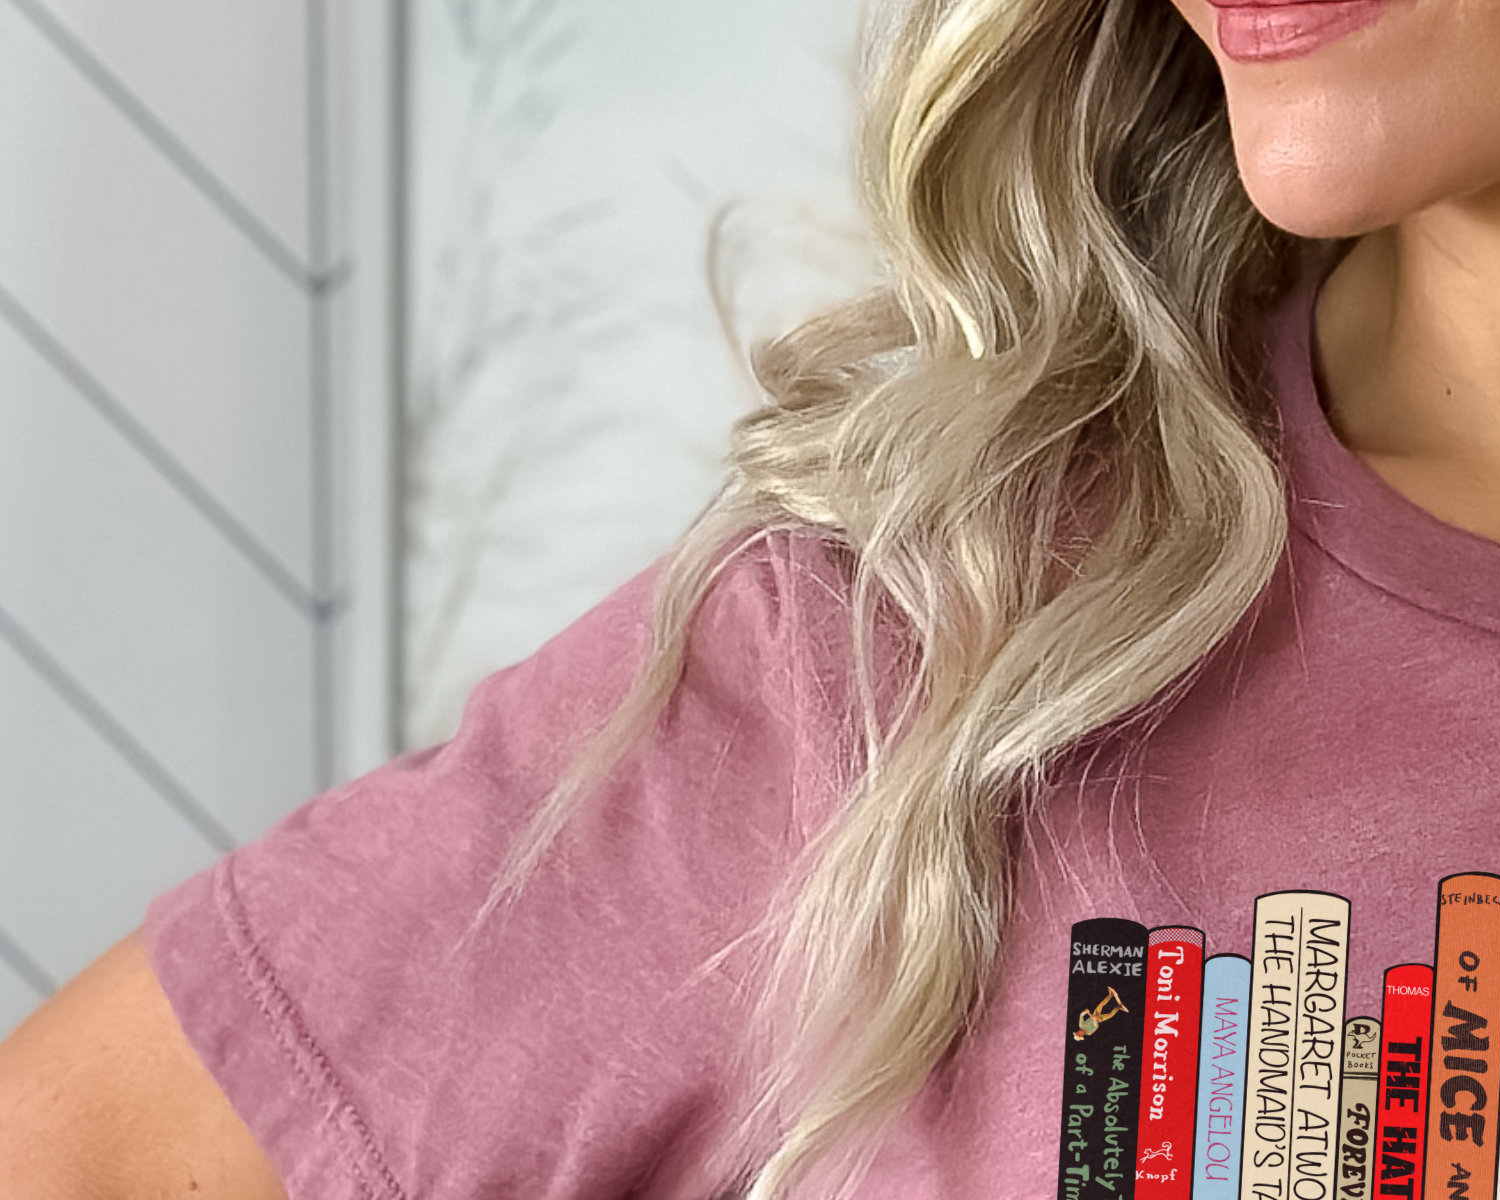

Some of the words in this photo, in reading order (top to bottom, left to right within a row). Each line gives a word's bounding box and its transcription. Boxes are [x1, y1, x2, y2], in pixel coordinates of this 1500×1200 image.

[1072, 942, 1144, 958] SHERMAN
[1072, 960, 1143, 977] ALEXIE
[1263, 915, 1295, 974] THE
[1458, 951, 1480, 992] OF
[1157, 946, 1184, 1001] Toni
[1387, 985, 1430, 996] THOMAS
[1212, 997, 1239, 1059] MAYA
[1299, 919, 1341, 1100] MARGARET
[1075, 1053, 1094, 1076] of
[1150, 1011, 1179, 1121] Morrison
[1254, 984, 1291, 1168] HANDMAID'S
[1346, 1051, 1376, 1059] POCKET
[1385, 1036, 1422, 1112] THE
[1439, 1000, 1490, 1147] MICE
[1075, 1084, 1087, 1094] a
[1095, 1078, 1129, 1190] Absolutely
[1205, 1064, 1235, 1181] ANGELOU
[1135, 1168, 1178, 1183] Knopf
